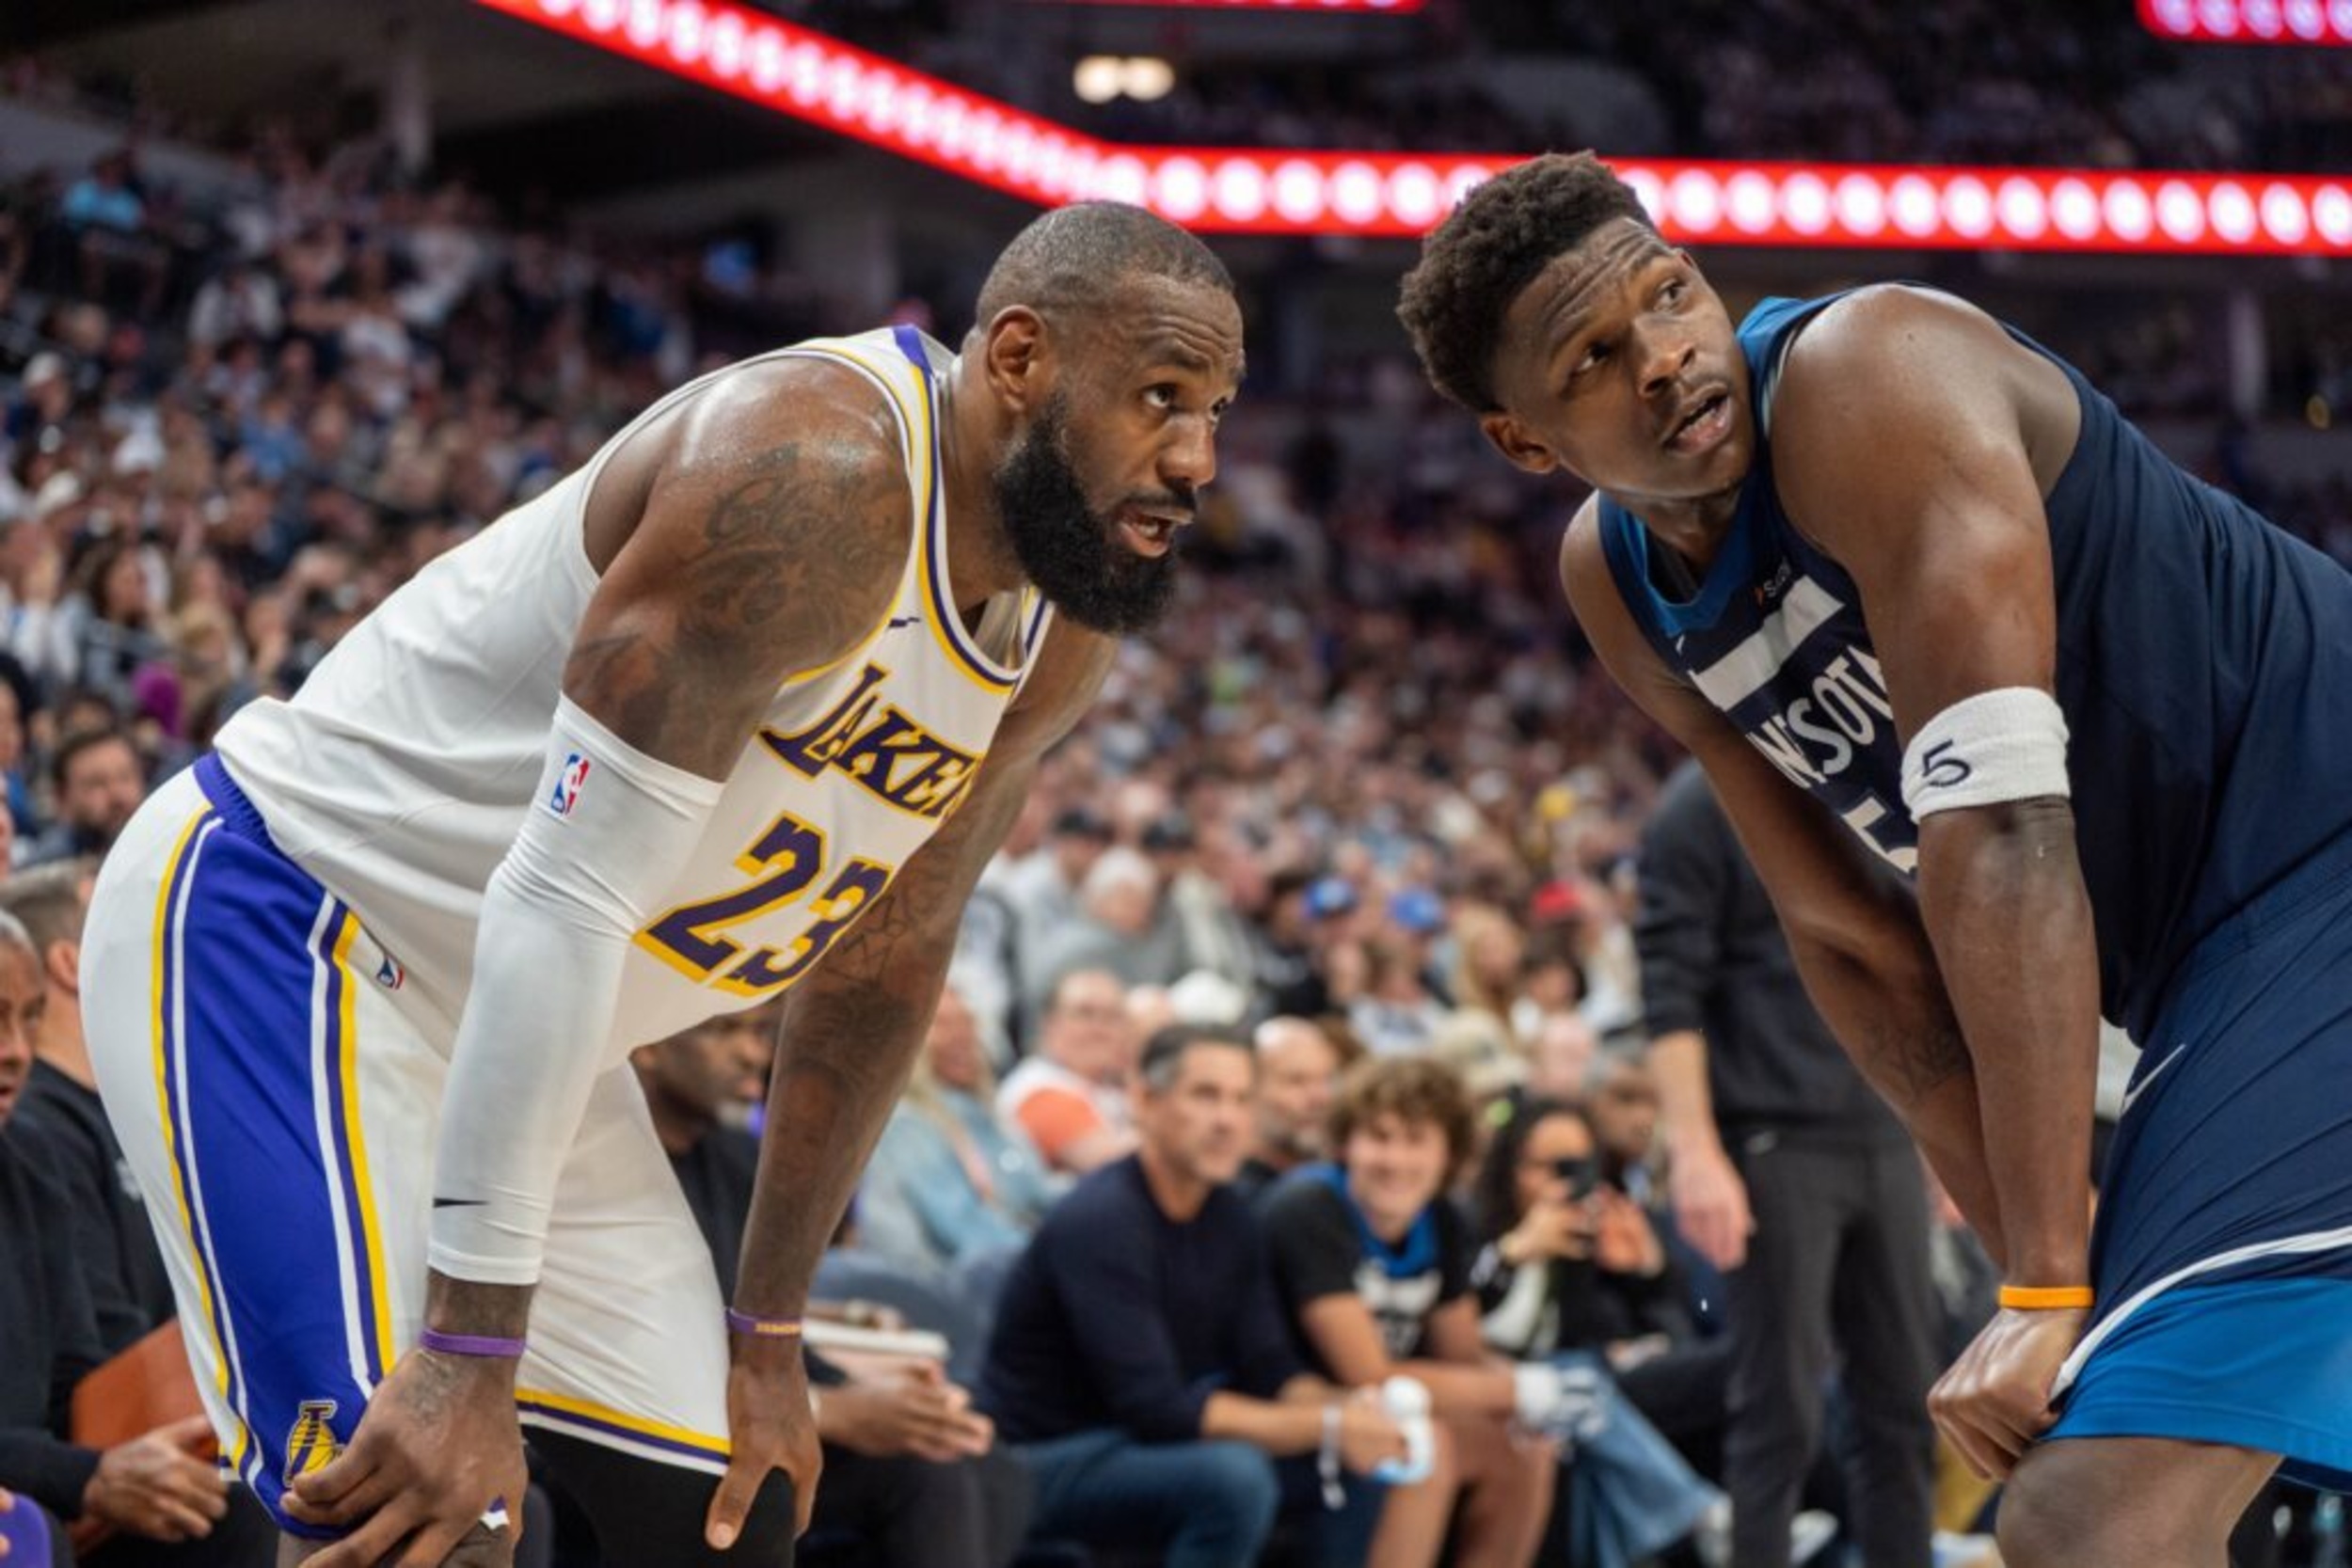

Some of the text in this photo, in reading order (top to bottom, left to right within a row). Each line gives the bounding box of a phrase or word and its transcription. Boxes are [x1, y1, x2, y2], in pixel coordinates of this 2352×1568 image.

[758, 661, 980, 818] LAKE
[1922, 738, 1971, 788] 5
[631, 810, 893, 997] 23
